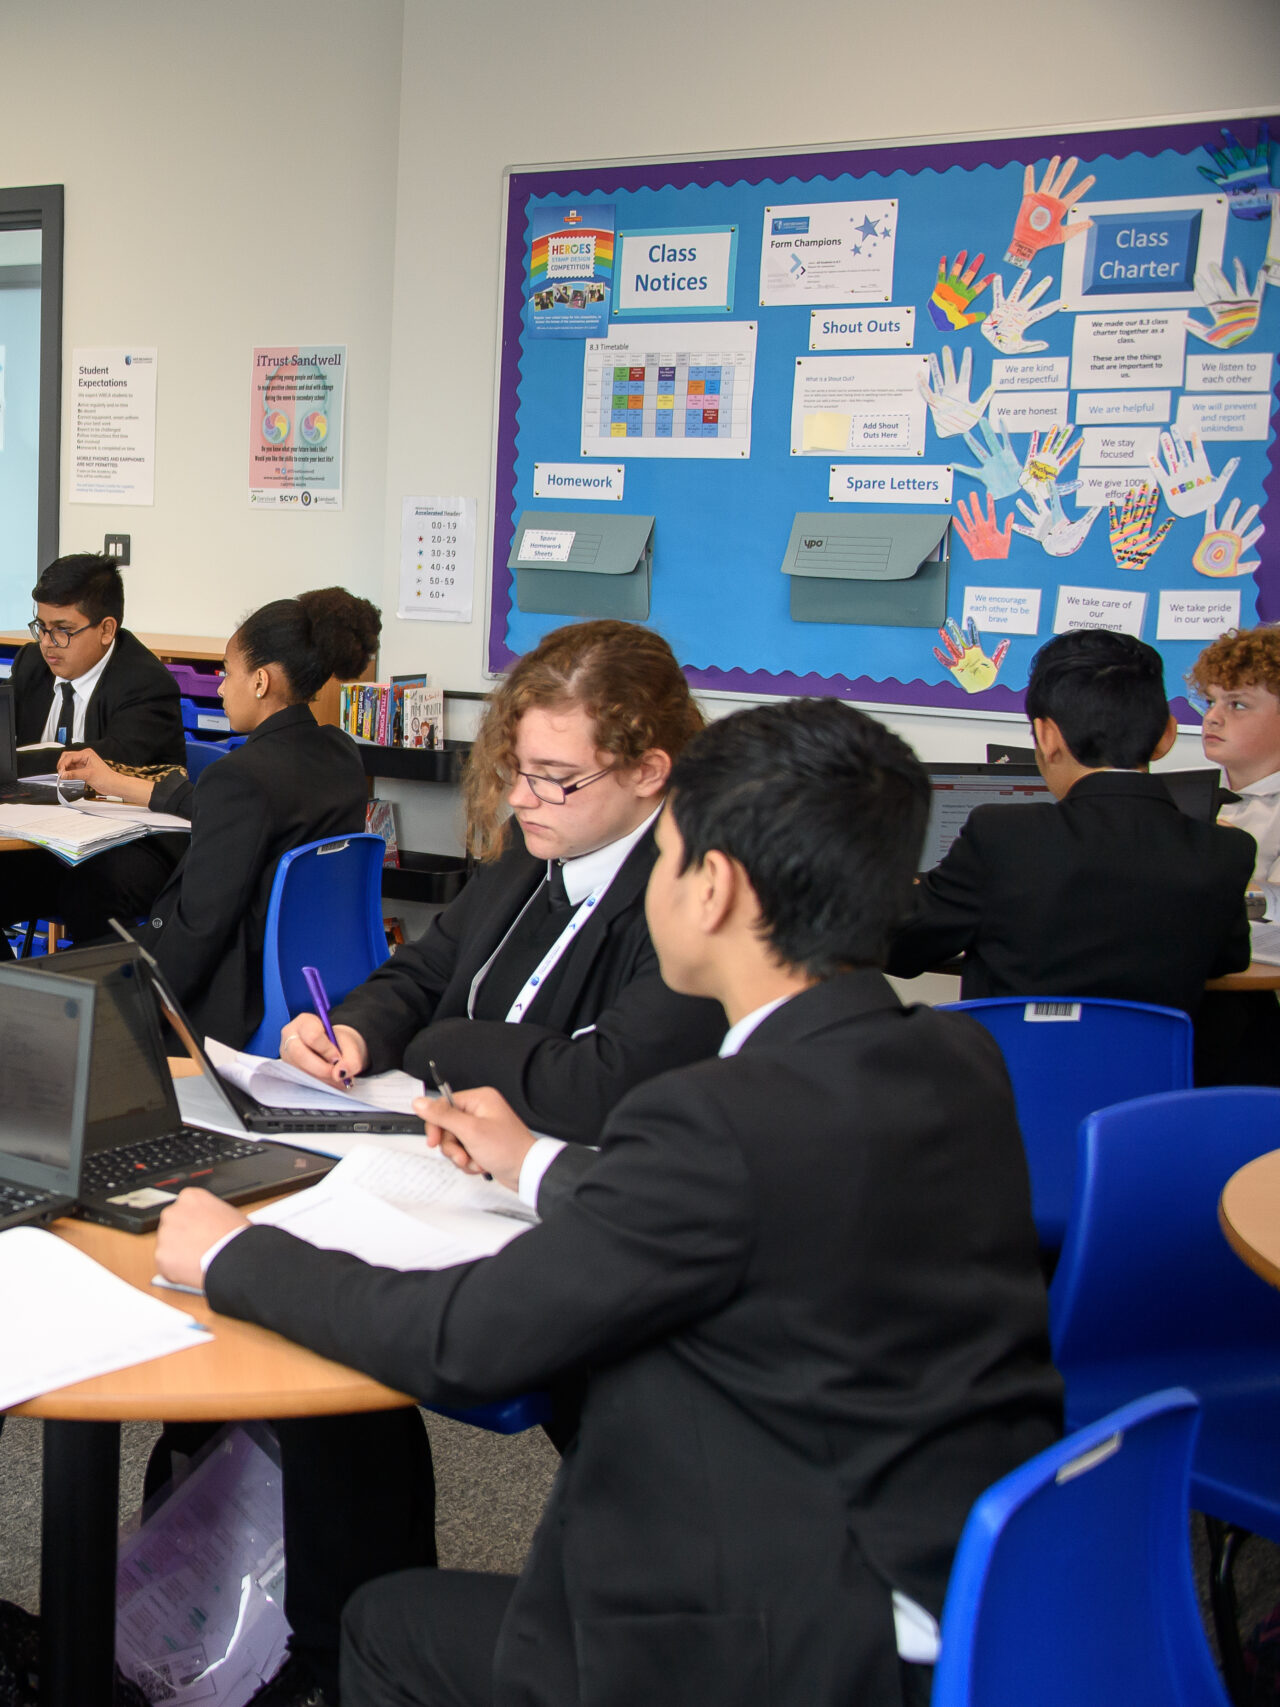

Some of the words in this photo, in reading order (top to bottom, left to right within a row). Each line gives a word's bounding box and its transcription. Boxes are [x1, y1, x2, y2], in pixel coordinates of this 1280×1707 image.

[770, 240, 792, 248] Form
[794, 238, 842, 249] Champions
[1116, 229, 1168, 248] Class
[552, 244, 591, 255] HEROES
[648, 244, 696, 262] Class
[1100, 260, 1180, 279] Charter
[635, 273, 708, 292] Notices
[823, 321, 863, 334] Shout
[867, 320, 900, 332] Outs
[257, 355, 289, 366] iTrust
[291, 354, 341, 366] Sandwell
[79, 366, 109, 375] Student
[1202, 363, 1216, 371] We
[1219, 363, 1243, 371] listen
[78, 379, 127, 389] Expectations
[1017, 375, 1058, 385] respectful
[1202, 375, 1224, 383] each
[1226, 375, 1252, 383] other
[1029, 407, 1057, 415] honest
[1123, 403, 1154, 413] helpful
[1219, 414, 1245, 422] report
[1100, 450, 1134, 458] focused
[548, 474, 612, 488] Homework
[847, 477, 885, 491] Spare
[890, 478, 938, 490] Letters
[1104, 480, 1122, 488] give
[804, 539, 823, 549] ypo
[988, 596, 1027, 604] encourage
[1067, 597, 1080, 605] We
[1082, 598, 1100, 607] take
[1122, 601, 1132, 609] of
[1170, 604, 1183, 612] We
[1186, 604, 1204, 612] take
[1208, 604, 1231, 613] pride
[1174, 615, 1182, 623] in
[1203, 615, 1224, 623] work
[1069, 620, 1122, 631] environment
